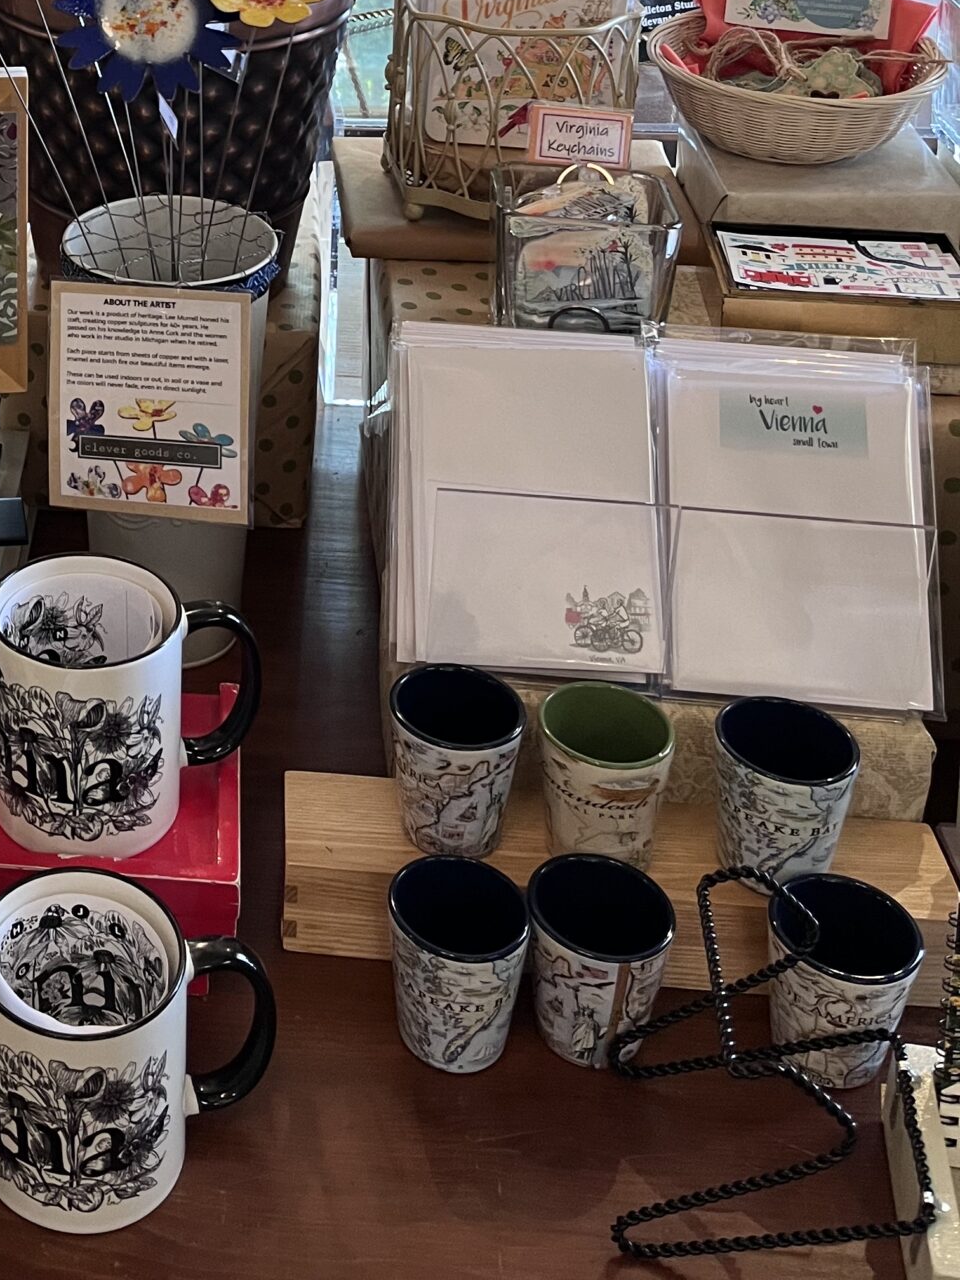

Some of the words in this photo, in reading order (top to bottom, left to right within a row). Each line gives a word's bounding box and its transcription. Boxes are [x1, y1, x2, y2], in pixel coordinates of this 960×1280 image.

[556, 120, 610, 139] Virginia
[547, 139, 616, 159] Keychains
[103, 298, 132, 308] ABOUT
[133, 299, 148, 309] THE
[149, 301, 177, 310] ARTIST
[764, 394, 790, 407] heart
[759, 409, 828, 435] Vienna
[792, 436, 814, 448] small
[817, 437, 839, 449] town
[84, 443, 128, 456] clever
[134, 447, 171, 459] goods
[176, 450, 198, 461] co.
